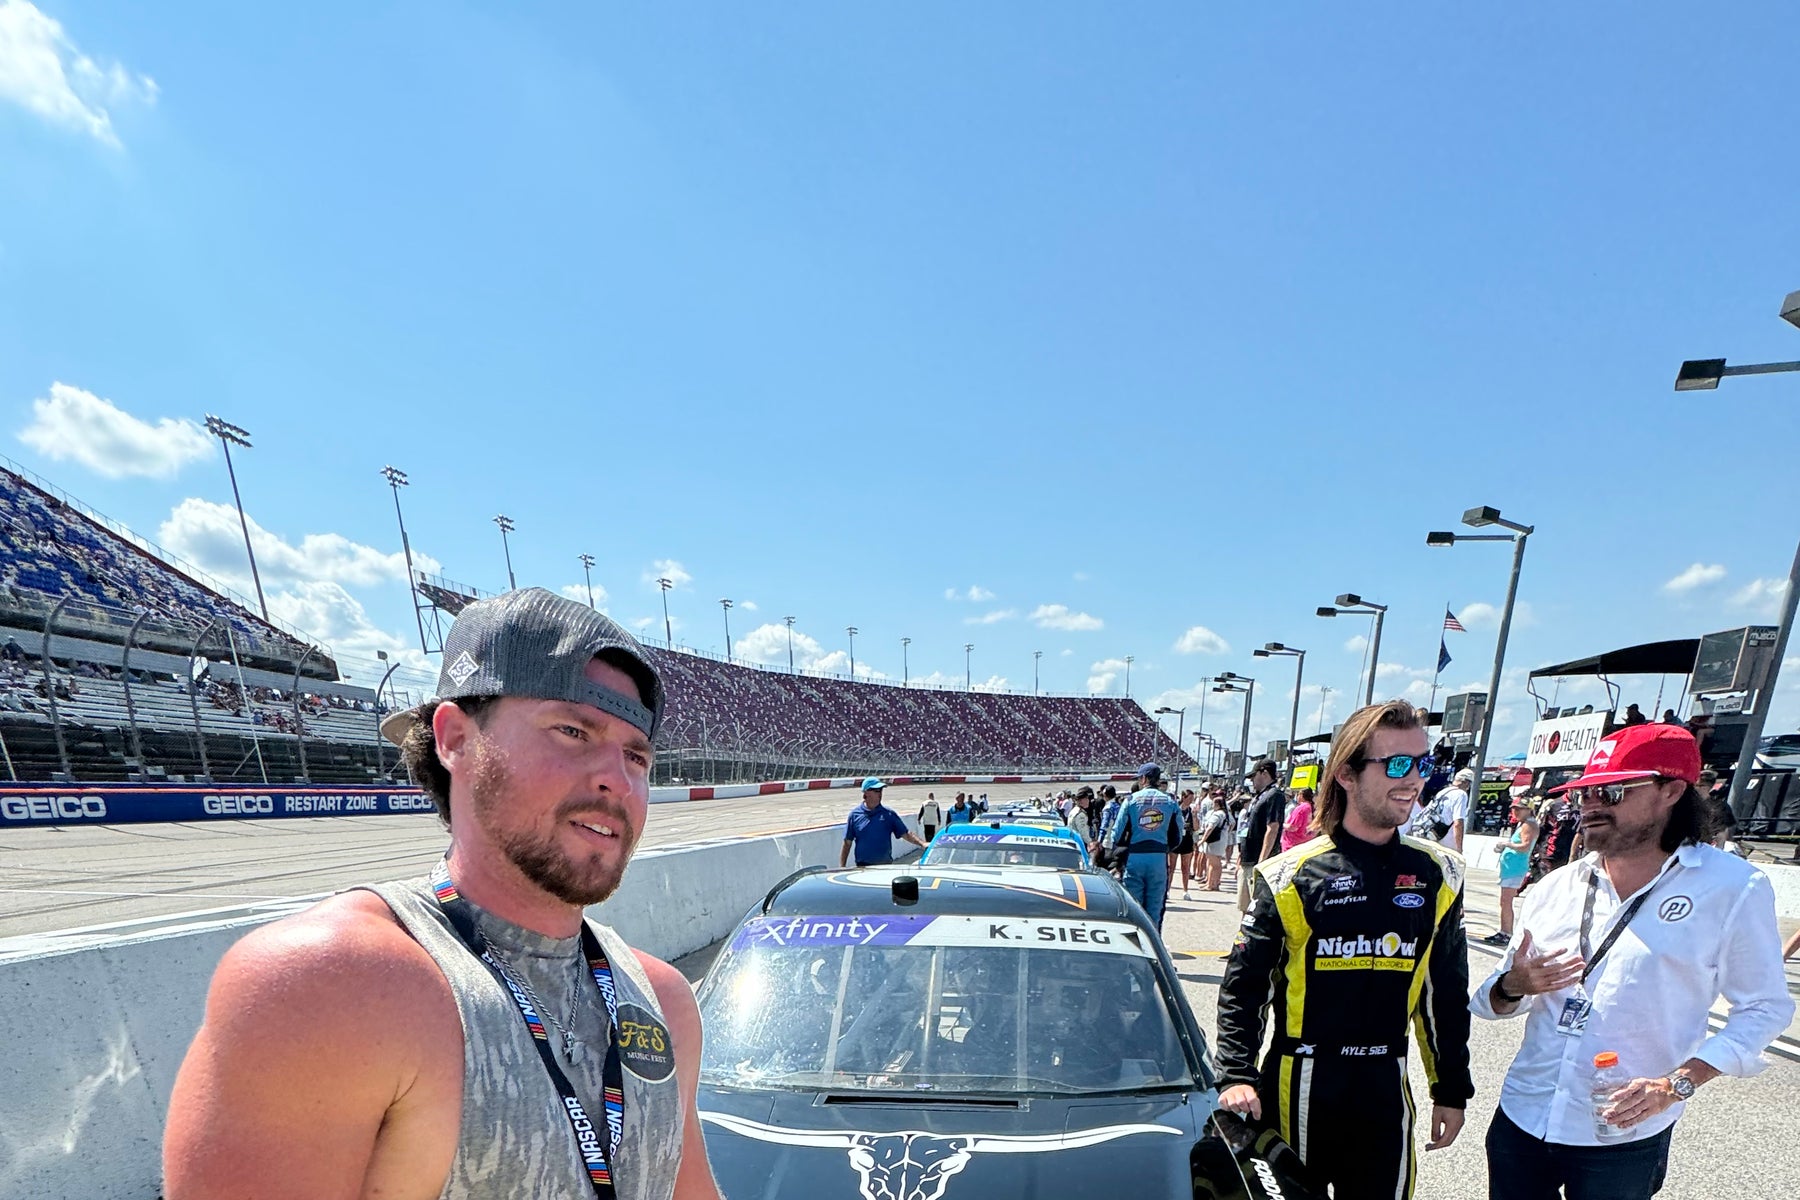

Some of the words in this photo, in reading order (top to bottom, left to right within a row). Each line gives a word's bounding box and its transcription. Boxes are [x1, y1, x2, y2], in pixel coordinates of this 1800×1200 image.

[1531, 733, 1549, 755] 10X
[1560, 727, 1600, 752] HEALTH
[3, 796, 107, 819] GEICO
[203, 795, 274, 815] GEICO
[285, 796, 344, 812] RESTART
[346, 795, 378, 811] ZONE
[947, 834, 991, 843] xfinity
[1016, 836, 1068, 845] PERKINS
[1399, 895, 1420, 906] Ford
[759, 917, 889, 945] xfinity
[989, 924, 1023, 940] K.
[1037, 924, 1111, 945] SIEG
[618, 1020, 666, 1053] F&S
[651, 1055, 668, 1064] FEST
[1341, 1045, 1368, 1056] KYLE
[564, 1096, 606, 1164] NASCAR
